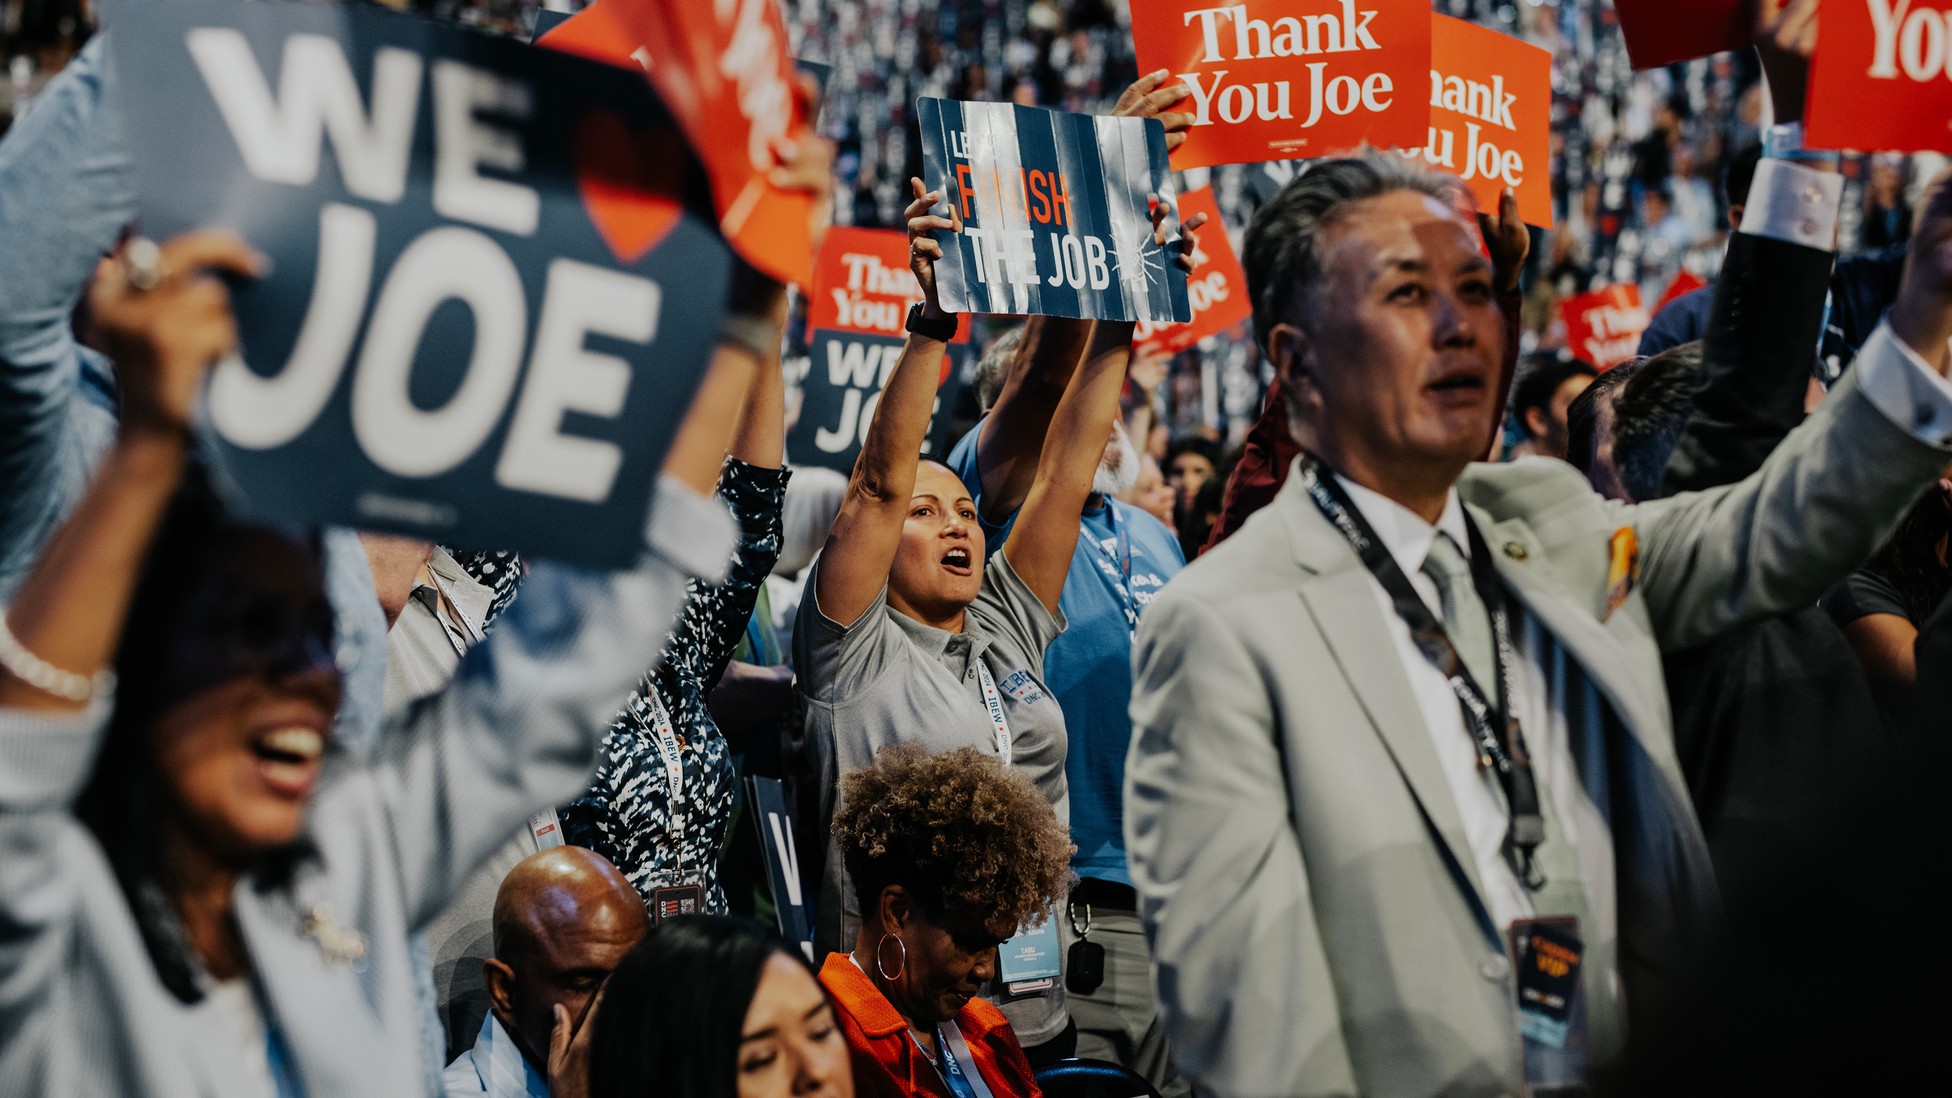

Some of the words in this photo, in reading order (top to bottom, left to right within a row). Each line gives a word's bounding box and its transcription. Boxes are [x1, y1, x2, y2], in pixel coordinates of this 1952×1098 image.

[1184, 0, 1382, 63] Thank
[1866, 0, 1952, 82] Yo
[1176, 70, 1294, 127] You
[1300, 62, 1394, 128] Joe
[1430, 69, 1517, 131] ank
[186, 27, 541, 237] WE
[1459, 121, 1524, 187] Joe
[841, 252, 924, 300] Tha
[964, 226, 1041, 285] THE
[1048, 232, 1110, 290] JOB
[832, 286, 899, 331] You
[1187, 271, 1230, 324] oe
[205, 203, 662, 502] JOE
[988, 697, 1003, 723] IBEW
[1000, 669, 1031, 694] IBE
[663, 736, 679, 763] IBEW
[944, 1050, 961, 1075] DNC
